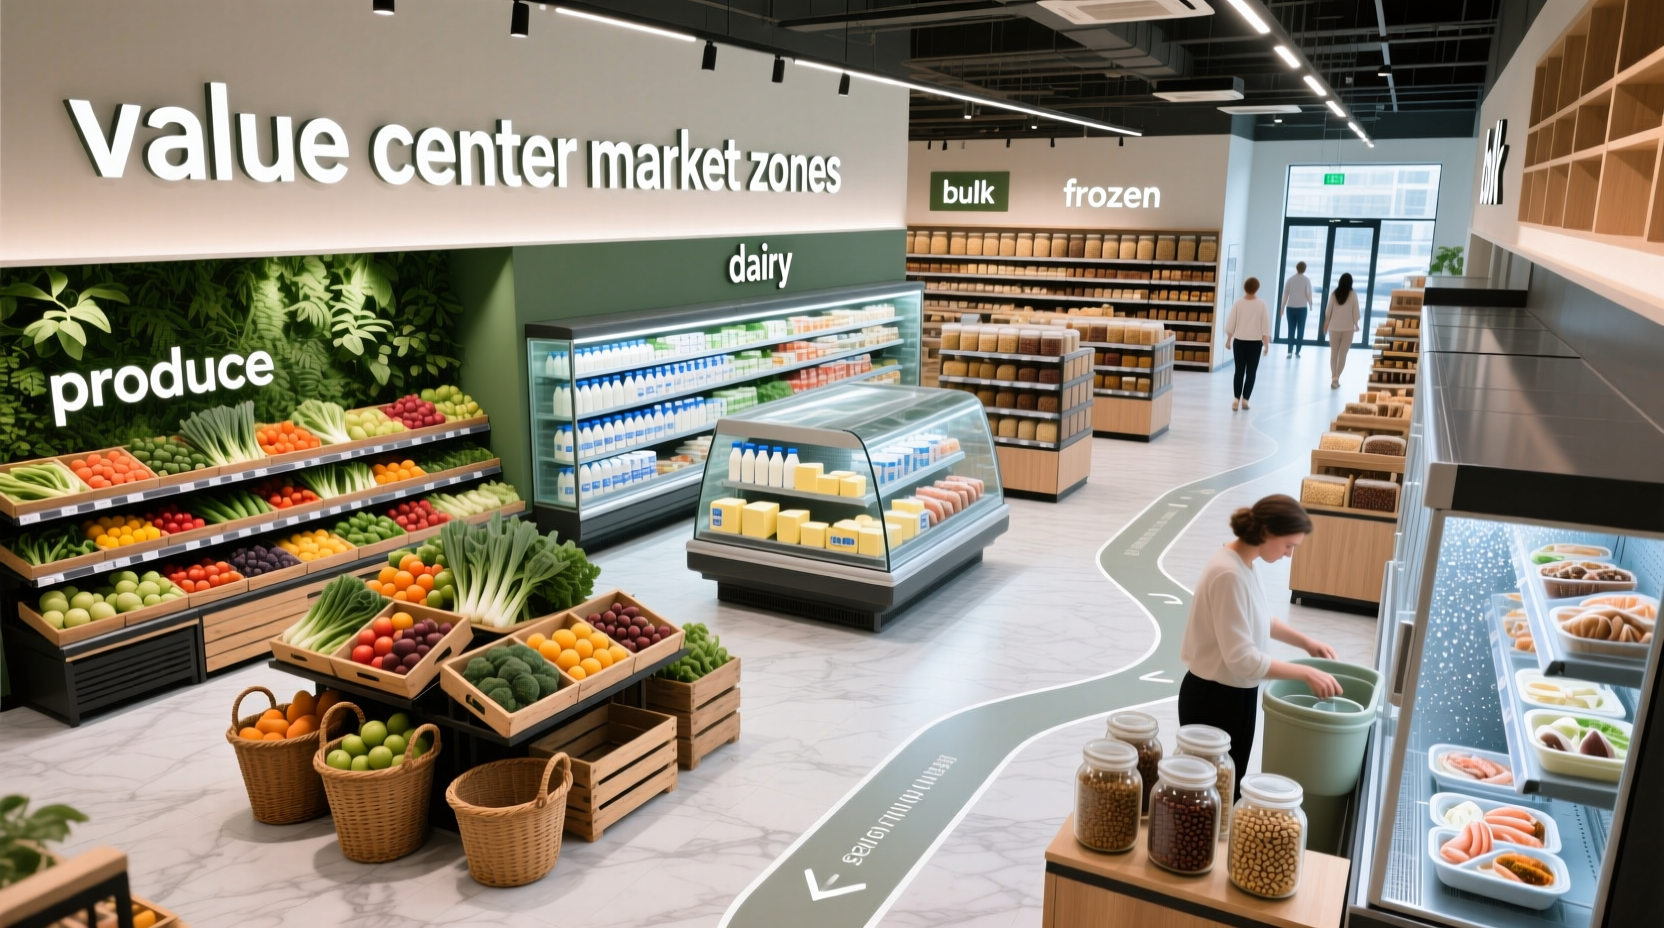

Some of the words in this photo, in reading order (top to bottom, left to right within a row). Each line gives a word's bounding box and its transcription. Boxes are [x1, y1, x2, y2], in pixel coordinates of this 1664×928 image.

[68, 82, 349, 186] value
[373, 120, 578, 190] center
[590, 129, 741, 192] market
[749, 147, 842, 194] zones
[943, 179, 995, 205] bulk
[1063, 178, 1161, 208] frozen
[728, 242, 793, 289] dairy
[50, 346, 274, 427] produce
